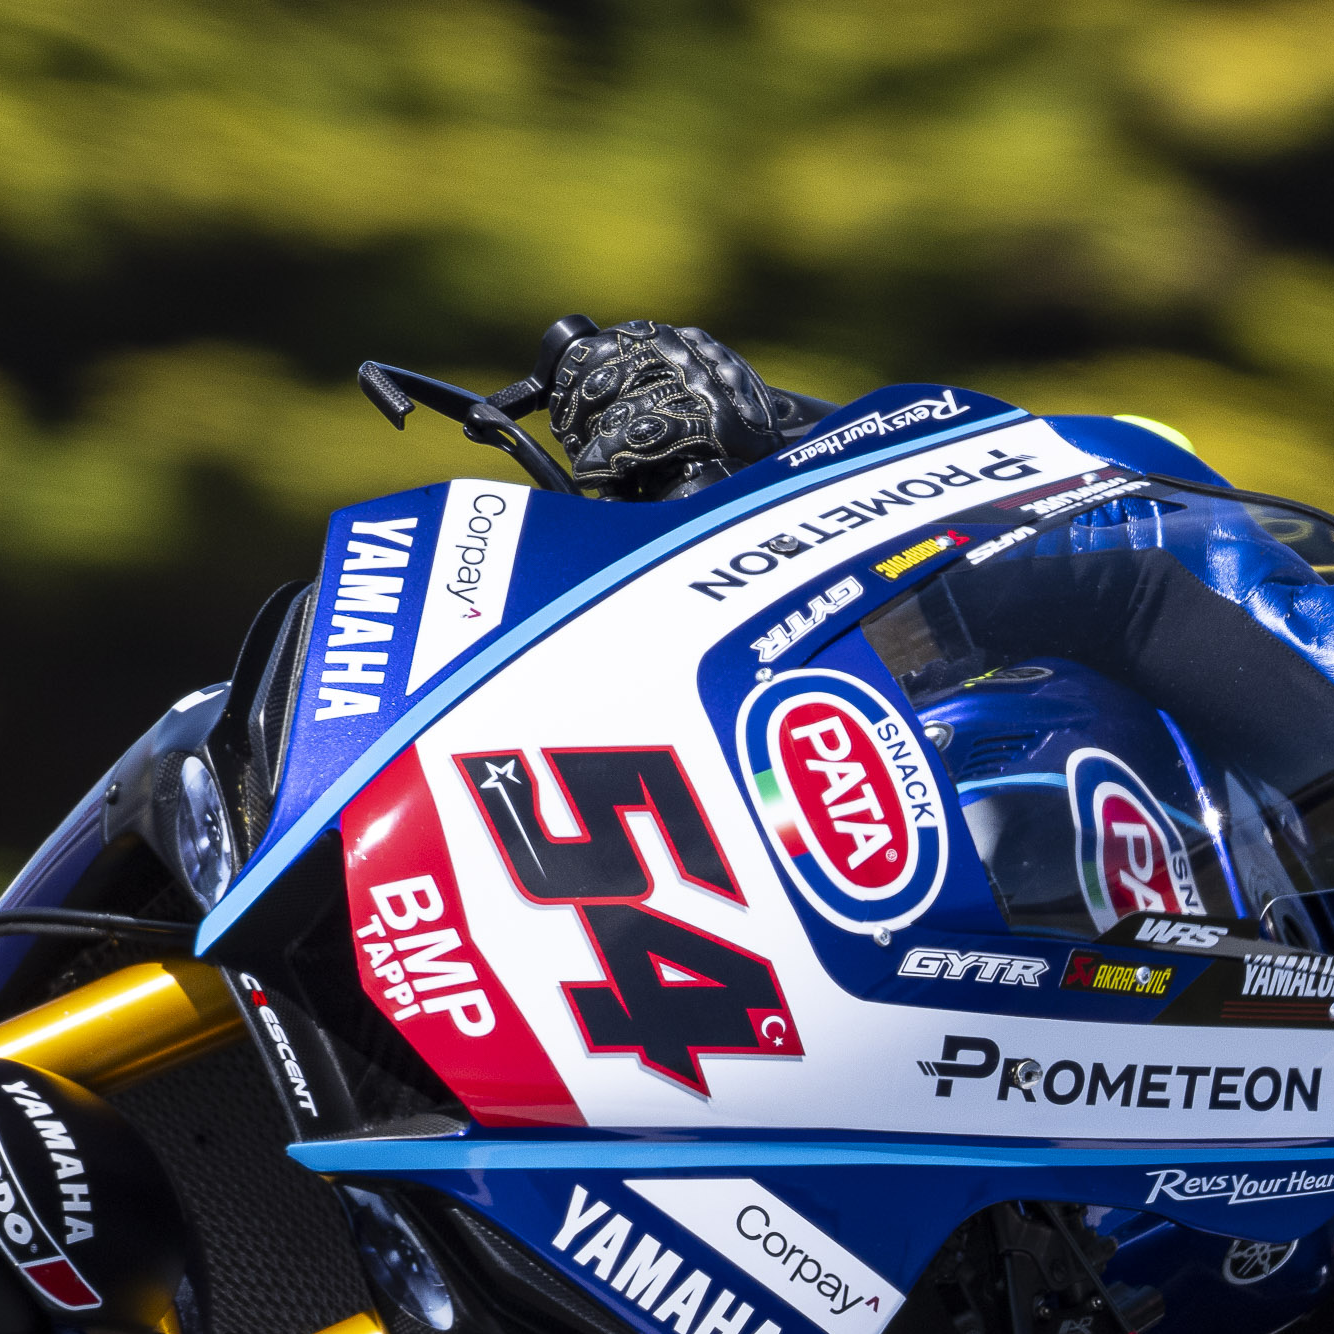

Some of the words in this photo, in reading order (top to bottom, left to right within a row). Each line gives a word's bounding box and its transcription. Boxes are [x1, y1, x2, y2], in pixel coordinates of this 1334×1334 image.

[785, 433, 843, 468] Heart
[842, 411, 904, 447] Your
[893, 389, 970, 430] Revs
[688, 450, 1043, 601] PROMETON
[314, 517, 418, 722] YAMAHA
[750, 575, 864, 663] GYTR
[791, 715, 888, 872] PATA
[877, 722, 936, 821] SNACK
[1111, 822, 1166, 913] PA
[367, 874, 496, 1038] BMP
[451, 745, 805, 1099] 54
[897, 946, 1051, 988] GYTR
[1135, 917, 1229, 949] WRS
[354, 914, 420, 1022] TAPPI
[916, 1034, 1323, 1112] PROMETEON
[2, 1081, 95, 1245] YAMAHA
[1145, 1169, 1230, 1205] Revs
[1227, 1173, 1288, 1205] Your
